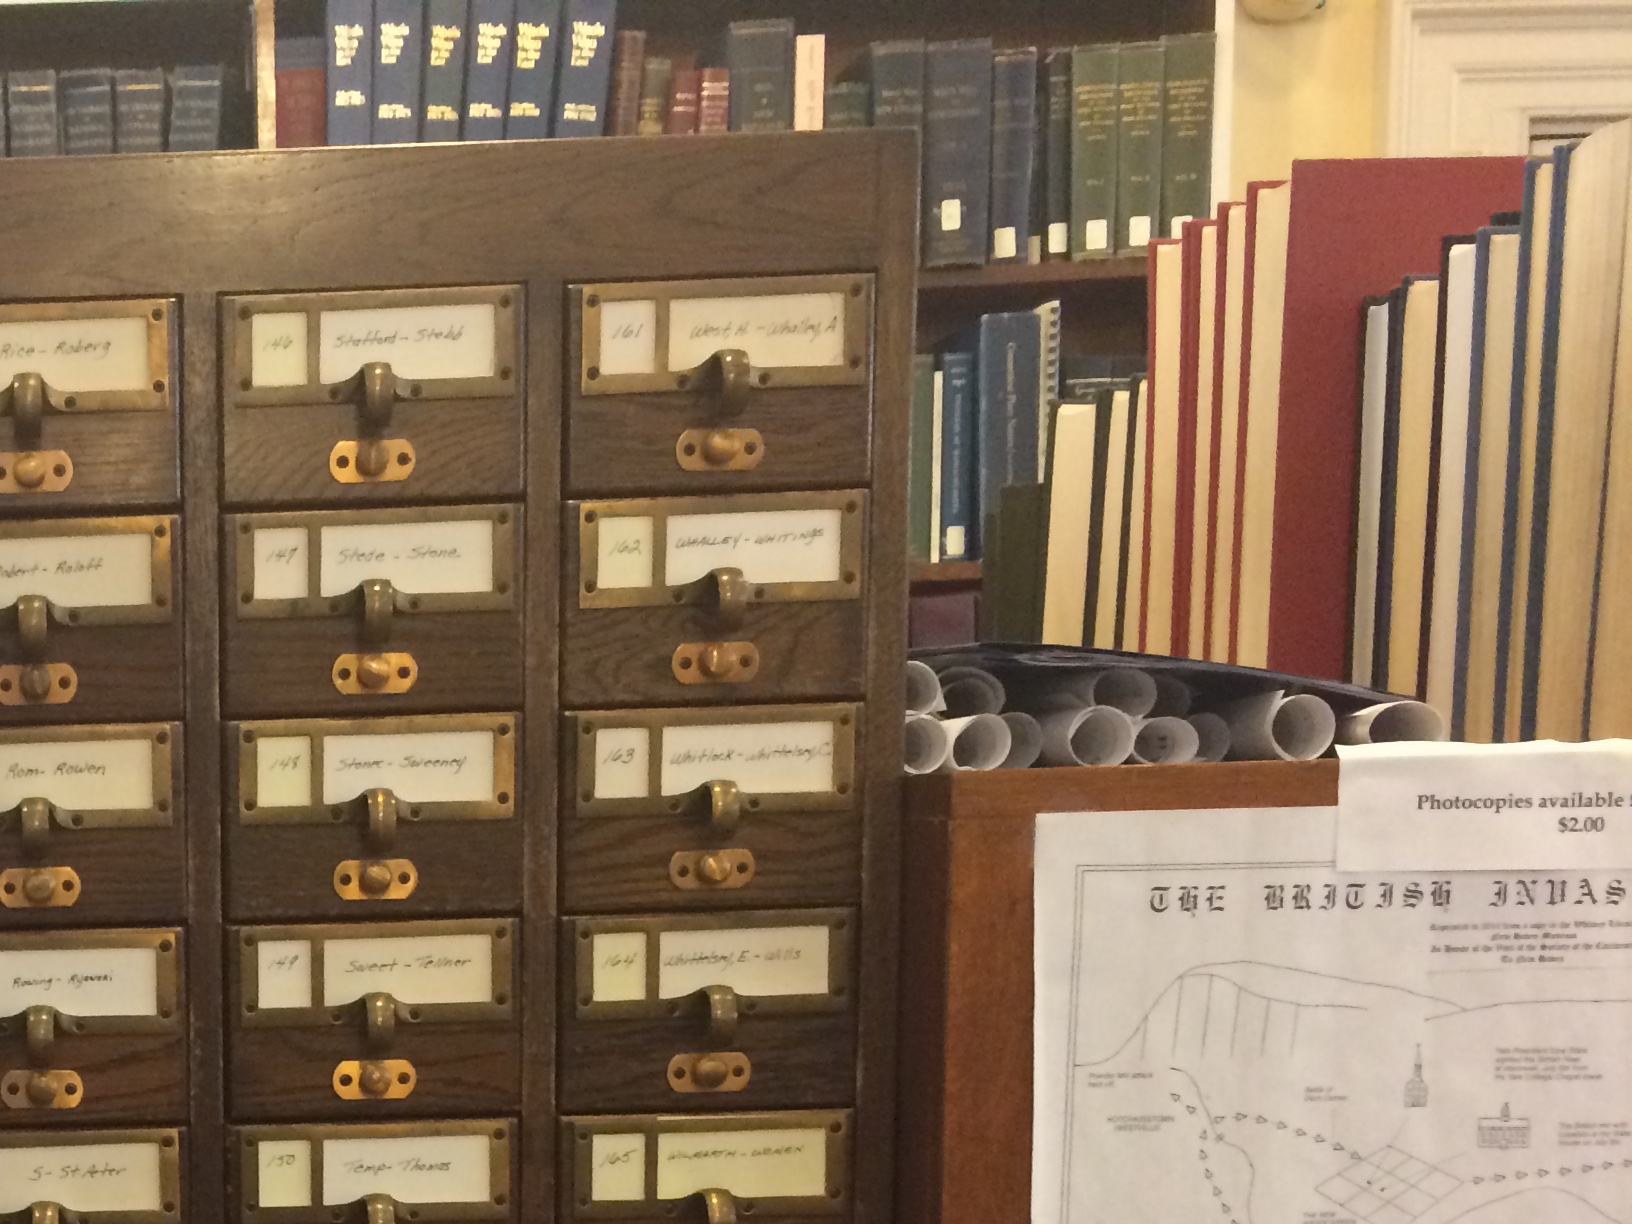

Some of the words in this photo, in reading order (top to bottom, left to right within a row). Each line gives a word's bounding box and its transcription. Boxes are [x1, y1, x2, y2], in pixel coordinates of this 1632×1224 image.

[334, 329, 399, 348] Stafford
[611, 322, 645, 340] 161
[53, 337, 113, 358] Roberg
[262, 334, 294, 351] 146
[608, 538, 643, 556] 162
[674, 534, 742, 550] WHALLEY
[266, 544, 300, 565] 147
[54, 556, 104, 575] Roloff
[270, 753, 303, 771] 148
[399, 754, 468, 775] Sweeney
[602, 747, 636, 765] 163
[1417, 793, 1533, 813] Photocopies
[1538, 791, 1624, 808] available
[1558, 816, 1605, 833] $2.00
[1149, 884, 1227, 912] THE
[1263, 879, 1453, 912] BRITISH
[271, 953, 300, 971] 149
[604, 951, 639, 969] 164
[735, 949, 751, 964] E
[267, 1153, 297, 1167] 150
[399, 1157, 452, 1172] Thomas
[599, 1148, 639, 1168] 165
